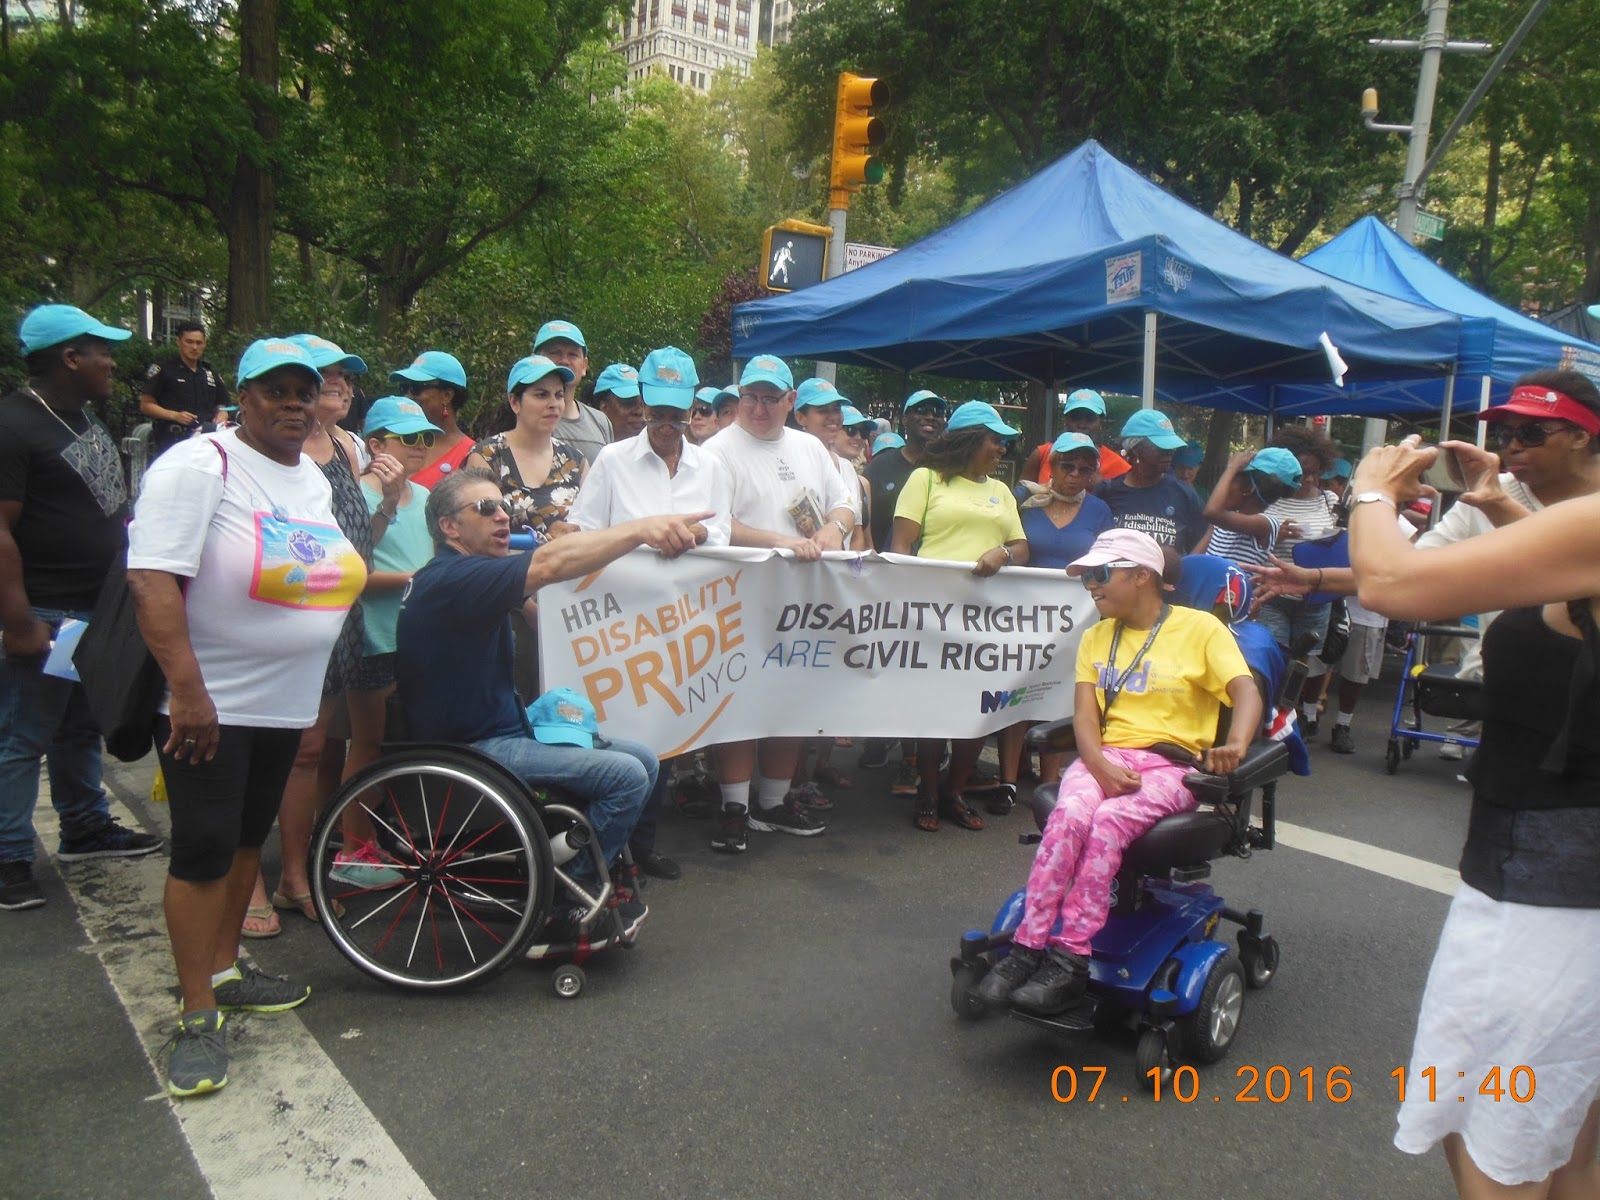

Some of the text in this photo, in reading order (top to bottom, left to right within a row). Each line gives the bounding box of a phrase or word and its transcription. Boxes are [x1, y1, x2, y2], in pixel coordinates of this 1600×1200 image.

[848, 248, 858, 257] NO
[1124, 513, 1176, 527] Enabling people
[1127, 520, 1177, 534] disabilities
[1146, 531, 1177, 546] IVE
[561, 592, 623, 633] HRA
[571, 569, 743, 667] DISABILITY
[776, 601, 1074, 635] DISABILITY RIGHTS
[582, 601, 745, 723] PRIDE
[762, 639, 1056, 671] ARE CIVIL RIGHTS
[688, 652, 747, 713] NYC
